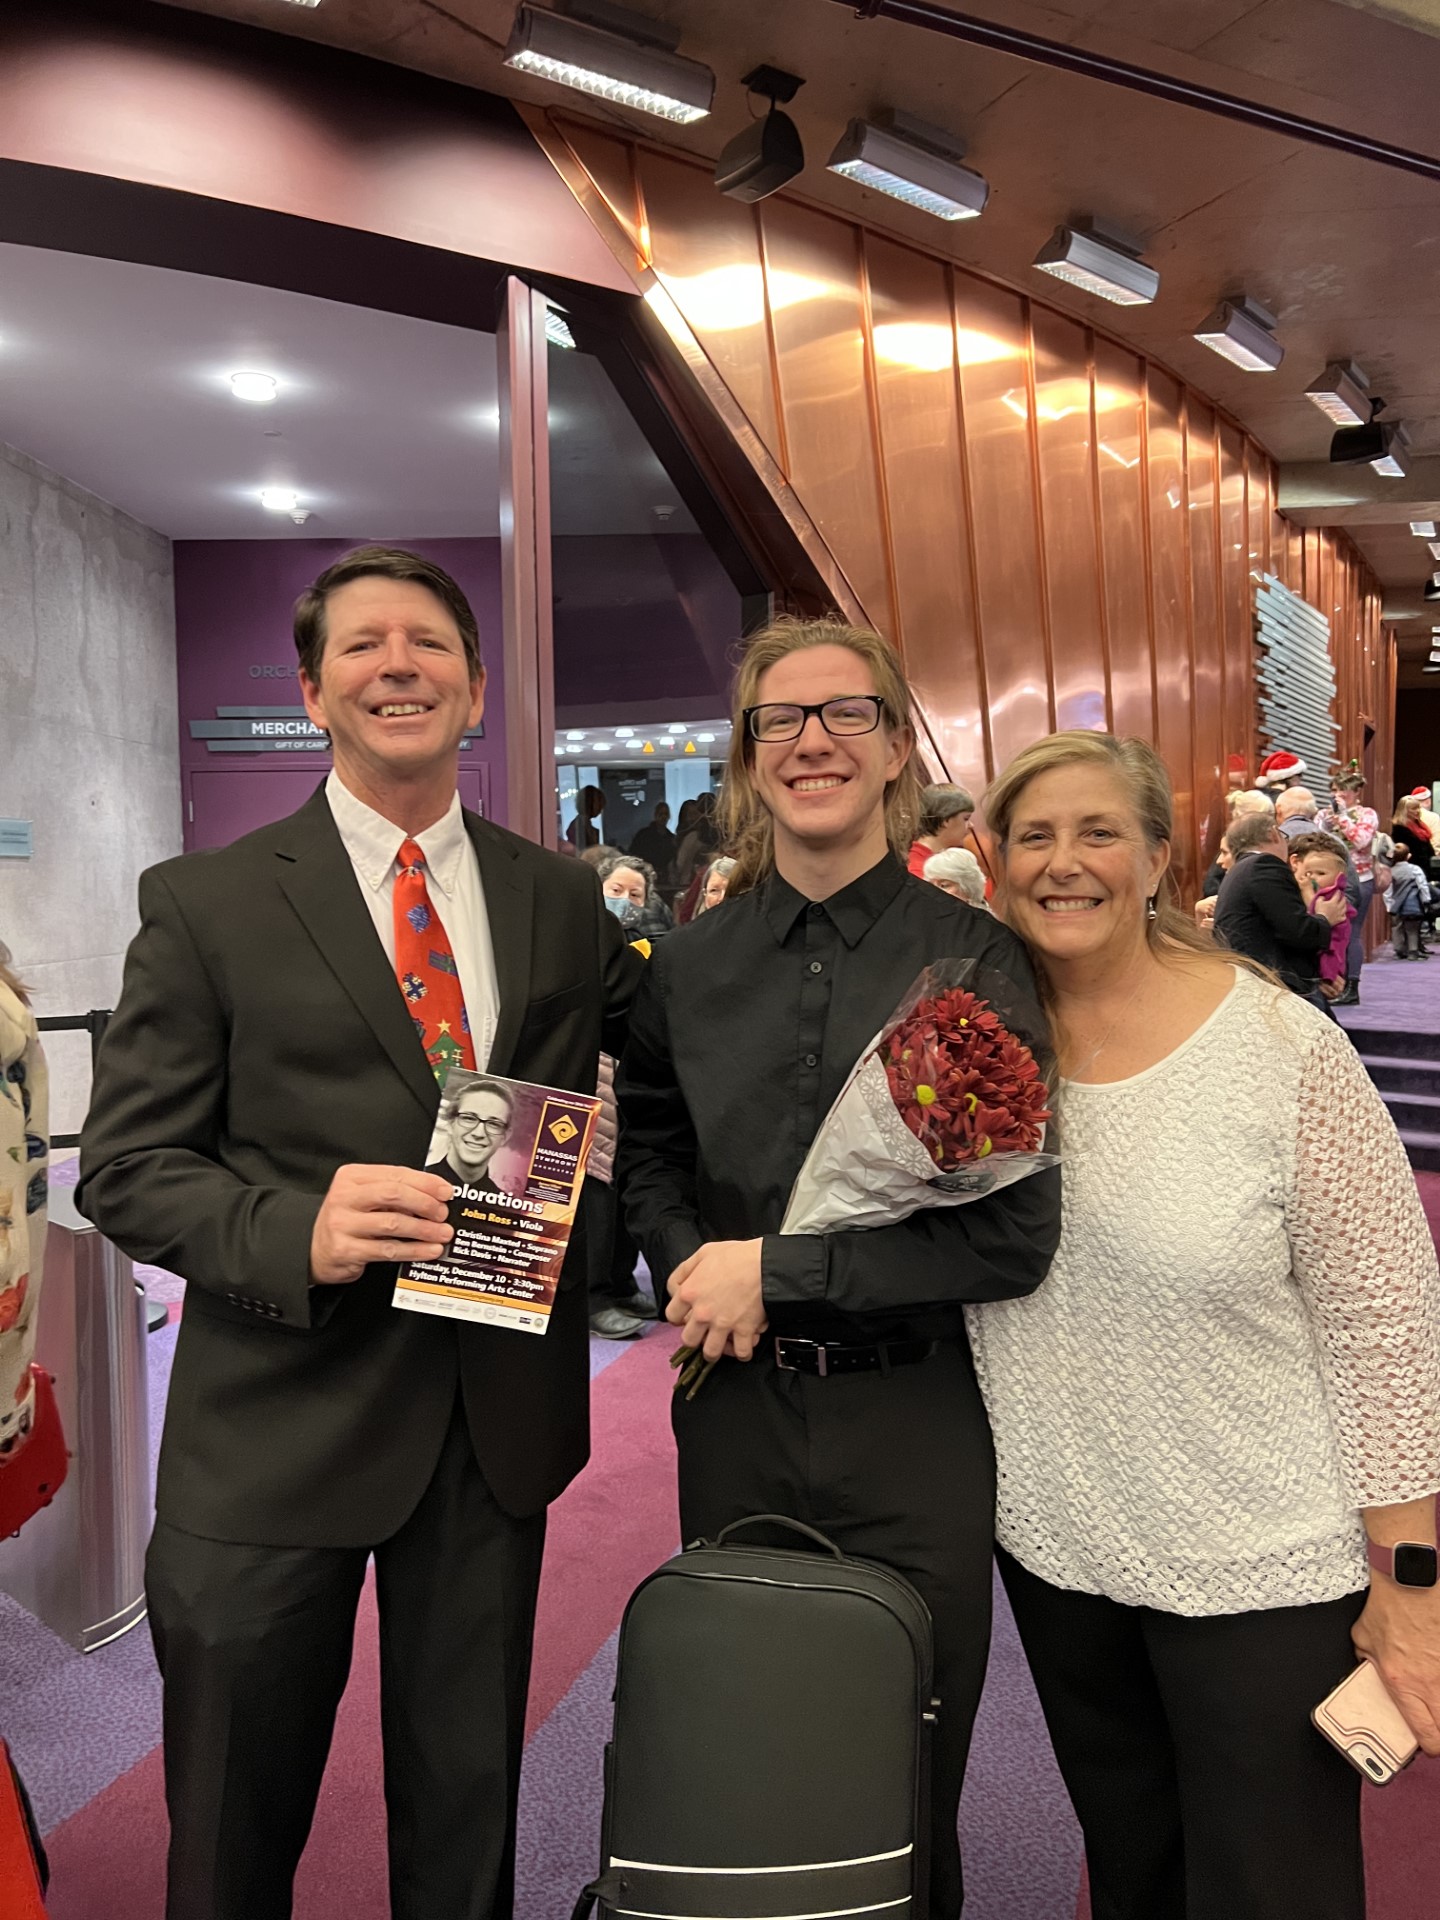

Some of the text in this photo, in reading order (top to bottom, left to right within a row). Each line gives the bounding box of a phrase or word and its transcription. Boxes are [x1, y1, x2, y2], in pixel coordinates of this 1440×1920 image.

[537, 1148, 578, 1162] MANASSAS
[461, 1208, 544, 1232] John Ross Viola
[454, 1237, 552, 1263] Ben Bernstein Composer
[456, 1229, 491, 1241] Christina
[526, 1243, 558, 1255] Soprano
[453, 1246, 531, 1267] Rick Davis Narrator
[408, 1269, 438, 1281] Hylton
[439, 1274, 487, 1292] Performing
[487, 1283, 506, 1294] Arts
[506, 1287, 536, 1299] Center
[452, 1266, 494, 1281] December
[495, 1274, 507, 1284] 10
[513, 1278, 545, 1291] 3:30pm
